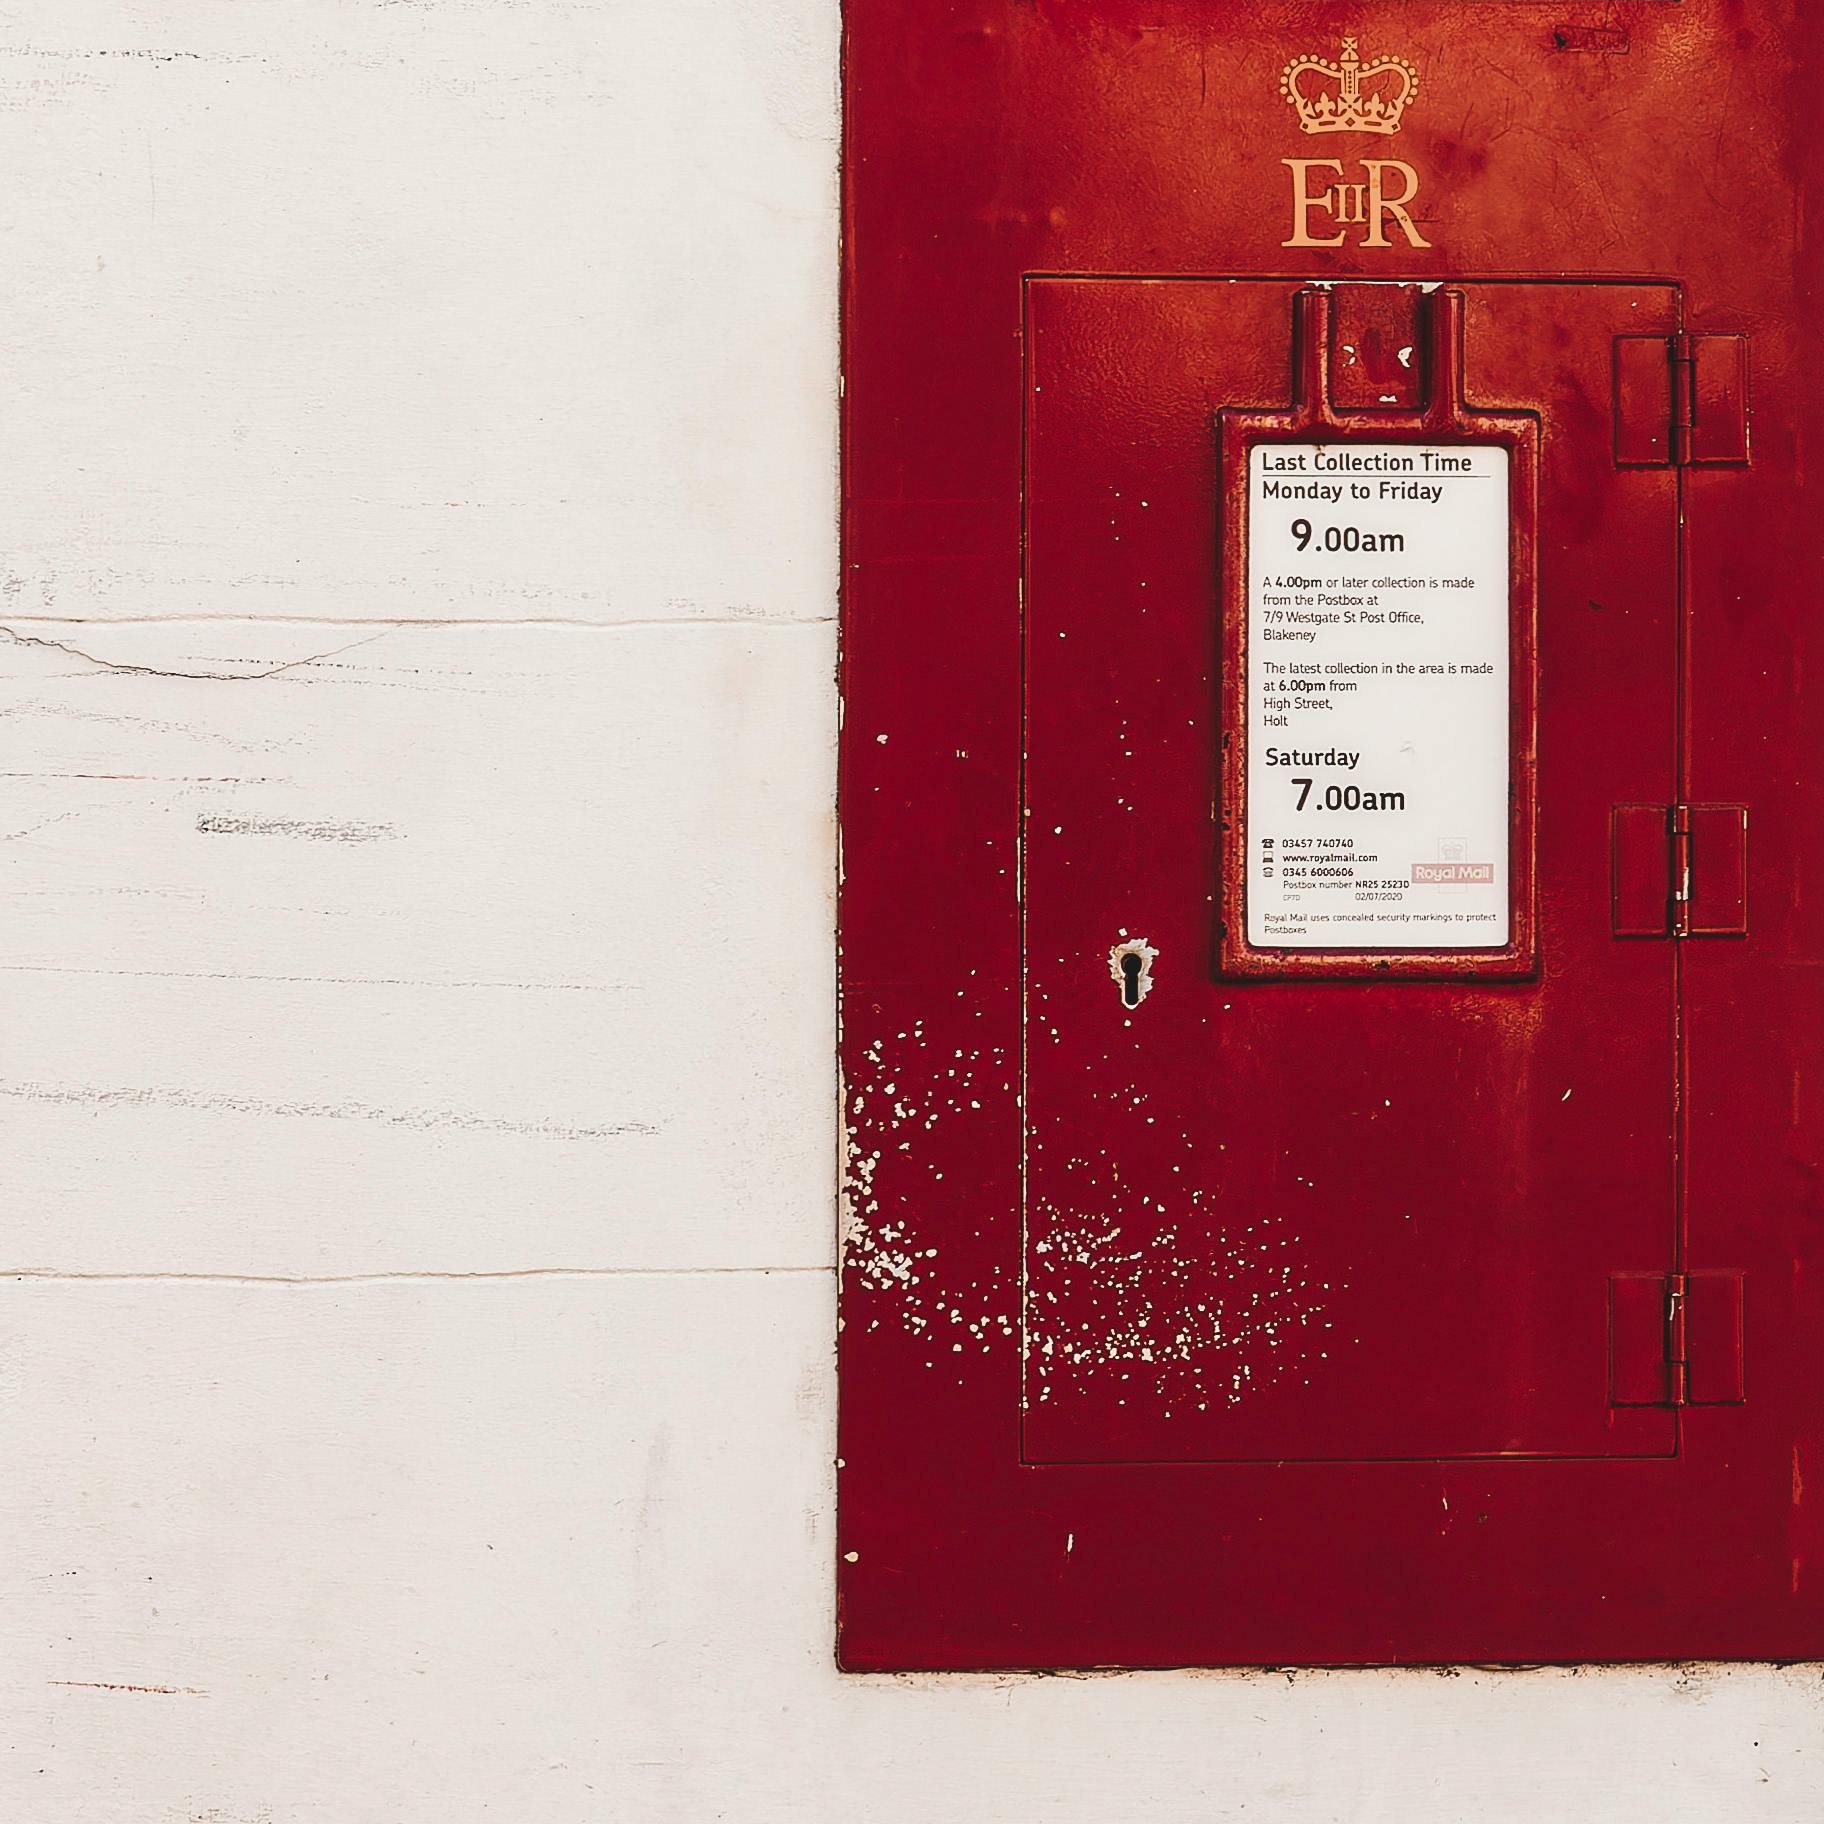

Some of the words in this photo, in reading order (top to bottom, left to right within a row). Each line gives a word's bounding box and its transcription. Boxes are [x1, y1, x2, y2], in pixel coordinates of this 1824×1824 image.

[1262, 452, 1307, 471] Last
[1314, 451, 1414, 472] Collection
[1419, 452, 1472, 472] Time
[1262, 480, 1344, 504] Monday
[1349, 482, 1371, 500] to
[1379, 480, 1443, 504] Friday
[1290, 518, 1405, 553] 9.00am
[1262, 576, 1272, 588] A
[1275, 575, 1323, 591] 4.00pm
[1325, 579, 1340, 589] or
[1342, 576, 1370, 589] later
[1371, 576, 1426, 589] collection
[1429, 576, 1439, 589] is
[1441, 576, 1475, 589] made
[1262, 593, 1291, 606] from
[1294, 594, 1314, 606] the
[1317, 593, 1364, 606] Postbox
[1366, 595, 1380, 606] at
[1263, 609, 1284, 624] 7/9
[1285, 610, 1341, 626] Westgate
[1343, 610, 1357, 624] St
[1359, 610, 1386, 624] Post
[1388, 610, 1425, 625] Office,
[1263, 628, 1317, 644] Blakeney
[1262, 661, 1287, 674] The
[1289, 662, 1322, 675] latest
[1324, 661, 1378, 675] collection
[1381, 662, 1393, 674] in
[1395, 662, 1416, 675] the
[1418, 664, 1445, 675] area
[1447, 661, 1457, 675] is
[1460, 661, 1494, 674] made
[1262, 681, 1276, 692] at
[1278, 679, 1326, 694] 6.00pm
[1329, 679, 1358, 692] from
[1263, 696, 1291, 712] High
[1293, 696, 1333, 711] Street,
[1263, 714, 1289, 727] Holt
[1265, 747, 1360, 771] Saturday
[1290, 778, 1405, 812] 7.00am
[1281, 838, 1314, 849] 03457
[1316, 838, 1354, 848] 740740
[1282, 852, 1378, 864] www.royalmail.com
[1282, 867, 1307, 877] 0345
[1310, 867, 1354, 877] 6000606
[1416, 866, 1454, 880] Royal
[1458, 866, 1489, 879] Mail
[1283, 880, 1317, 890] Postbox
[1318, 880, 1353, 889] number
[1355, 879, 1379, 889] NR25
[1264, 913, 1288, 924] Royal
[1289, 913, 1308, 922] Mail
[1332, 913, 1374, 922] concealed
[1376, 913, 1411, 923] security
[1412, 913, 1453, 923] markings
[1454, 913, 1464, 922] to
[1466, 913, 1497, 923] protect
[1264, 925, 1307, 934] Postboxes
